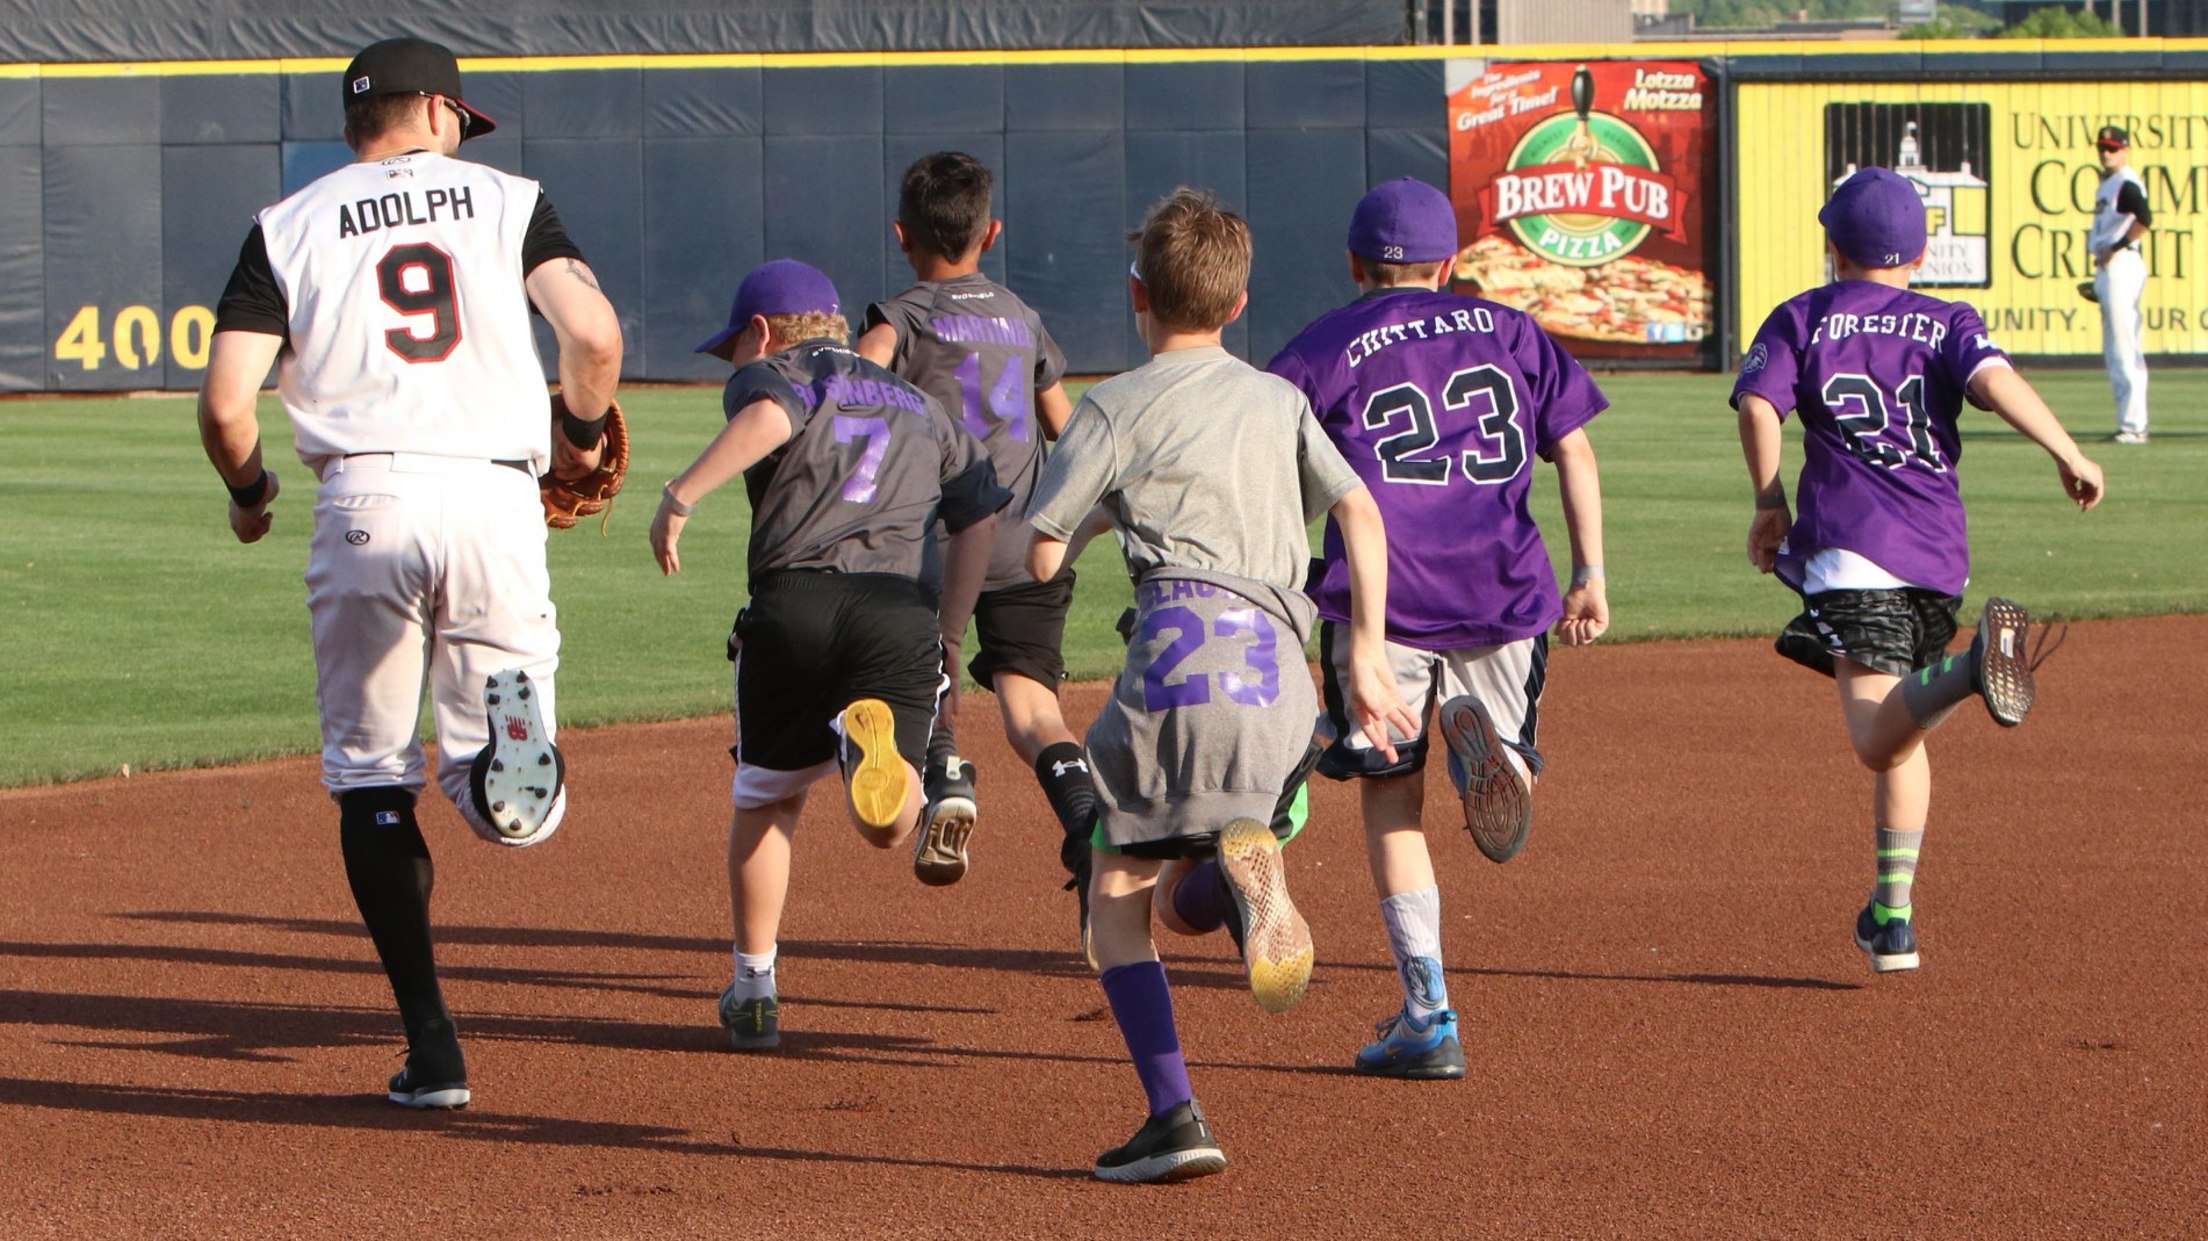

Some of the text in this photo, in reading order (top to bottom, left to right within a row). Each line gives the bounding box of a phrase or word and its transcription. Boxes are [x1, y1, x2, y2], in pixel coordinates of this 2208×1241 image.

[1623, 87, 1702, 111] Motzza
[1635, 68, 1696, 89] Lotzza
[1457, 86, 1558, 131] Great Time!
[340, 186, 474, 239] ADOLPH
[1495, 165, 1669, 220] BREW PUB
[1384, 246, 1404, 260] 23
[1539, 227, 1623, 259] PIZZA
[1884, 252, 1900, 265] 21
[376, 242, 463, 364] 9
[55, 305, 217, 370] 400
[1347, 307, 1495, 368] CHITTARO
[1811, 312, 1947, 354] FORESTER
[954, 352, 1030, 443] 14
[1362, 363, 1527, 486] 23
[1821, 372, 1948, 474] 21
[832, 415, 891, 504] 7
[1142, 605, 1280, 713] 23
